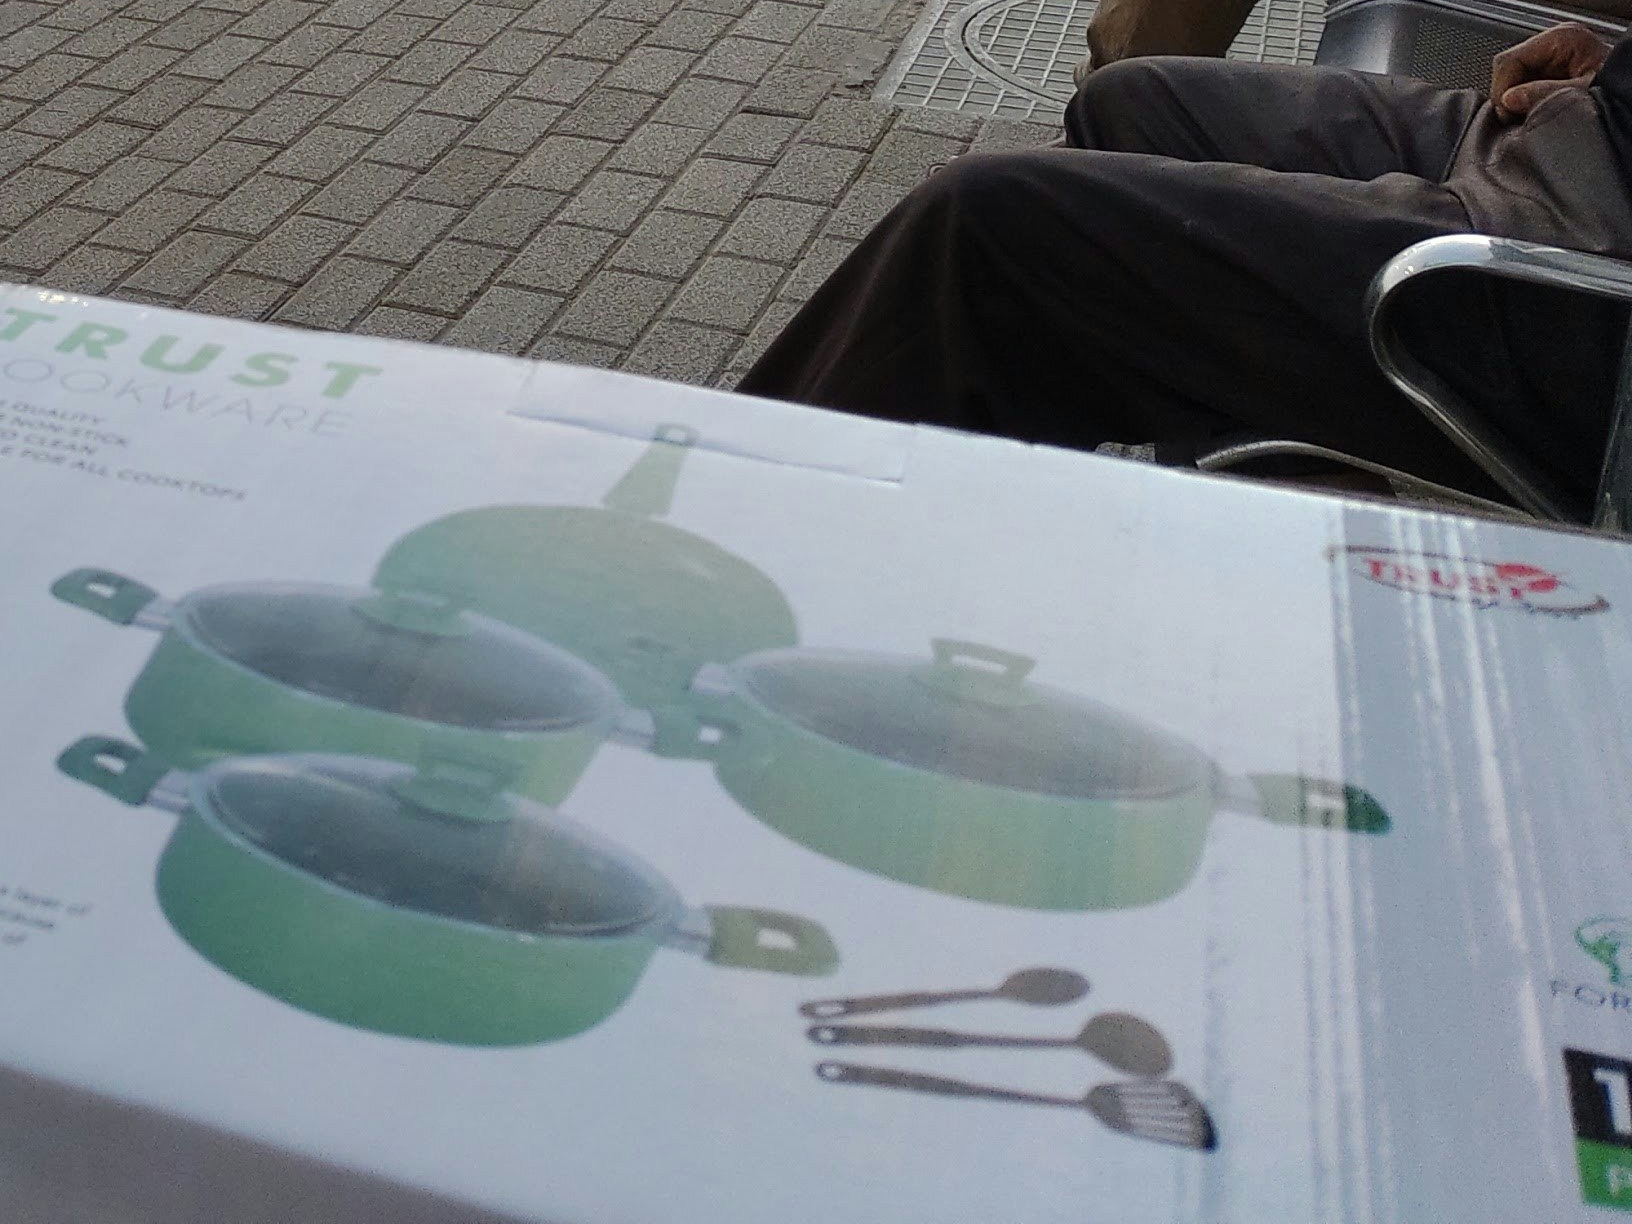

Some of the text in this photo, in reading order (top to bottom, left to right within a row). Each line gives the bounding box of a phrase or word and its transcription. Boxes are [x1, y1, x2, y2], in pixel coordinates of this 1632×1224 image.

[23, 434, 98, 456] CLEAN
[21, 448, 67, 466] FOR
[71, 459, 110, 478] ALL
[117, 468, 248, 501] COOKTOPS
